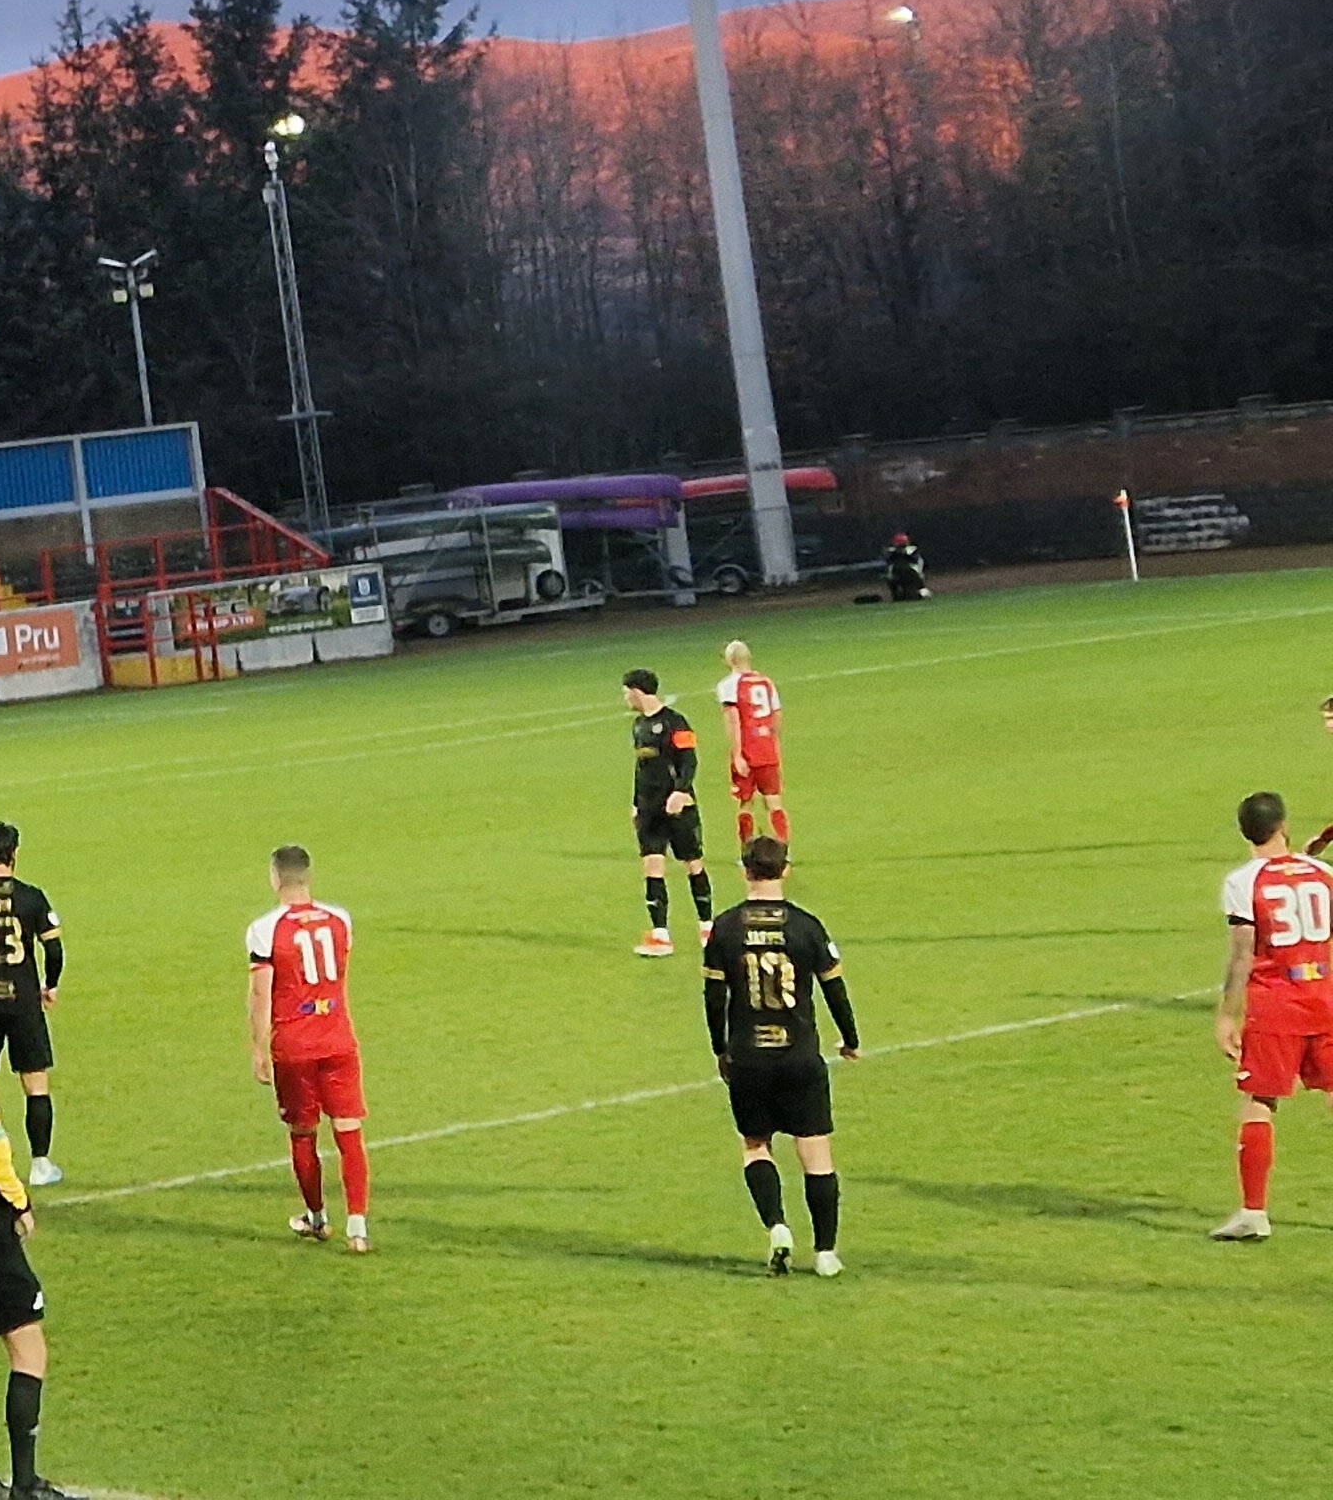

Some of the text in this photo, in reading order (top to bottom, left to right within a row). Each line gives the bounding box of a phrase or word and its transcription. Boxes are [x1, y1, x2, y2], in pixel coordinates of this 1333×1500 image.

[13, 624, 61, 653] Pru
[748, 684, 772, 718] 9
[1261, 880, 1331, 947] 30
[293, 925, 338, 985] 11
